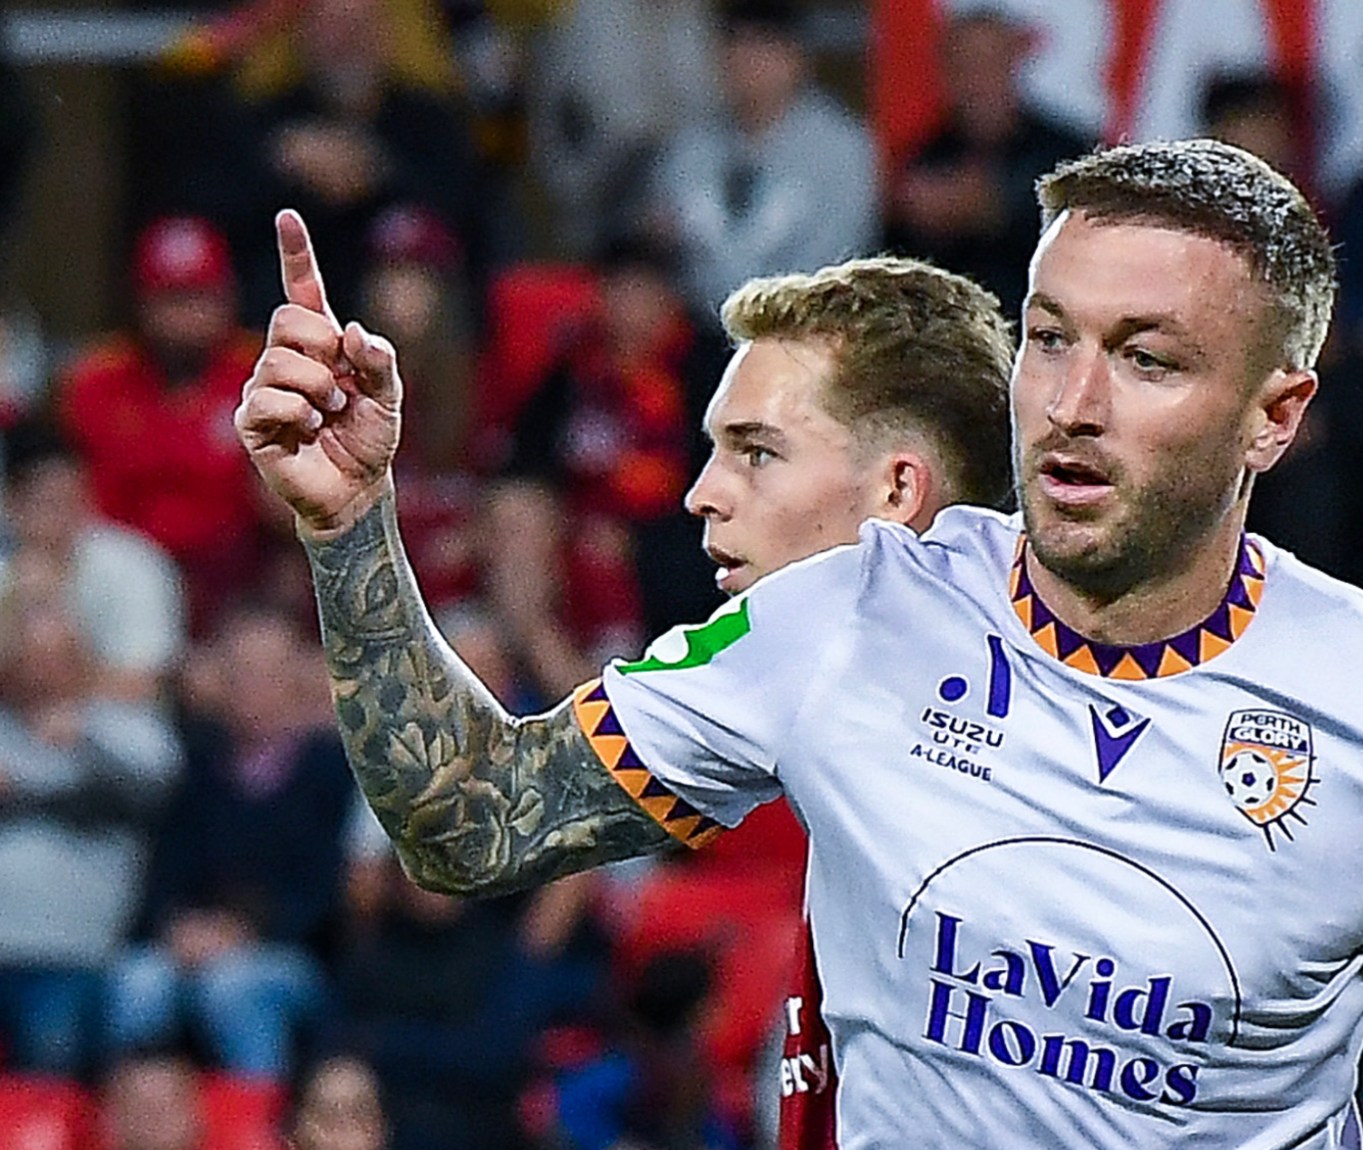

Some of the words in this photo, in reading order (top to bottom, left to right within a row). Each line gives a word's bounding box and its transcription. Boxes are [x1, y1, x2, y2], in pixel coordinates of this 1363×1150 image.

[921, 708, 1004, 748] ISUZU
[1233, 727, 1303, 750] GLORY
[1240, 713, 1301, 735] PERTH
[910, 744, 992, 782] A-LEAGUE
[929, 910, 1213, 1043] LaVida
[922, 978, 1199, 1107] Homes
